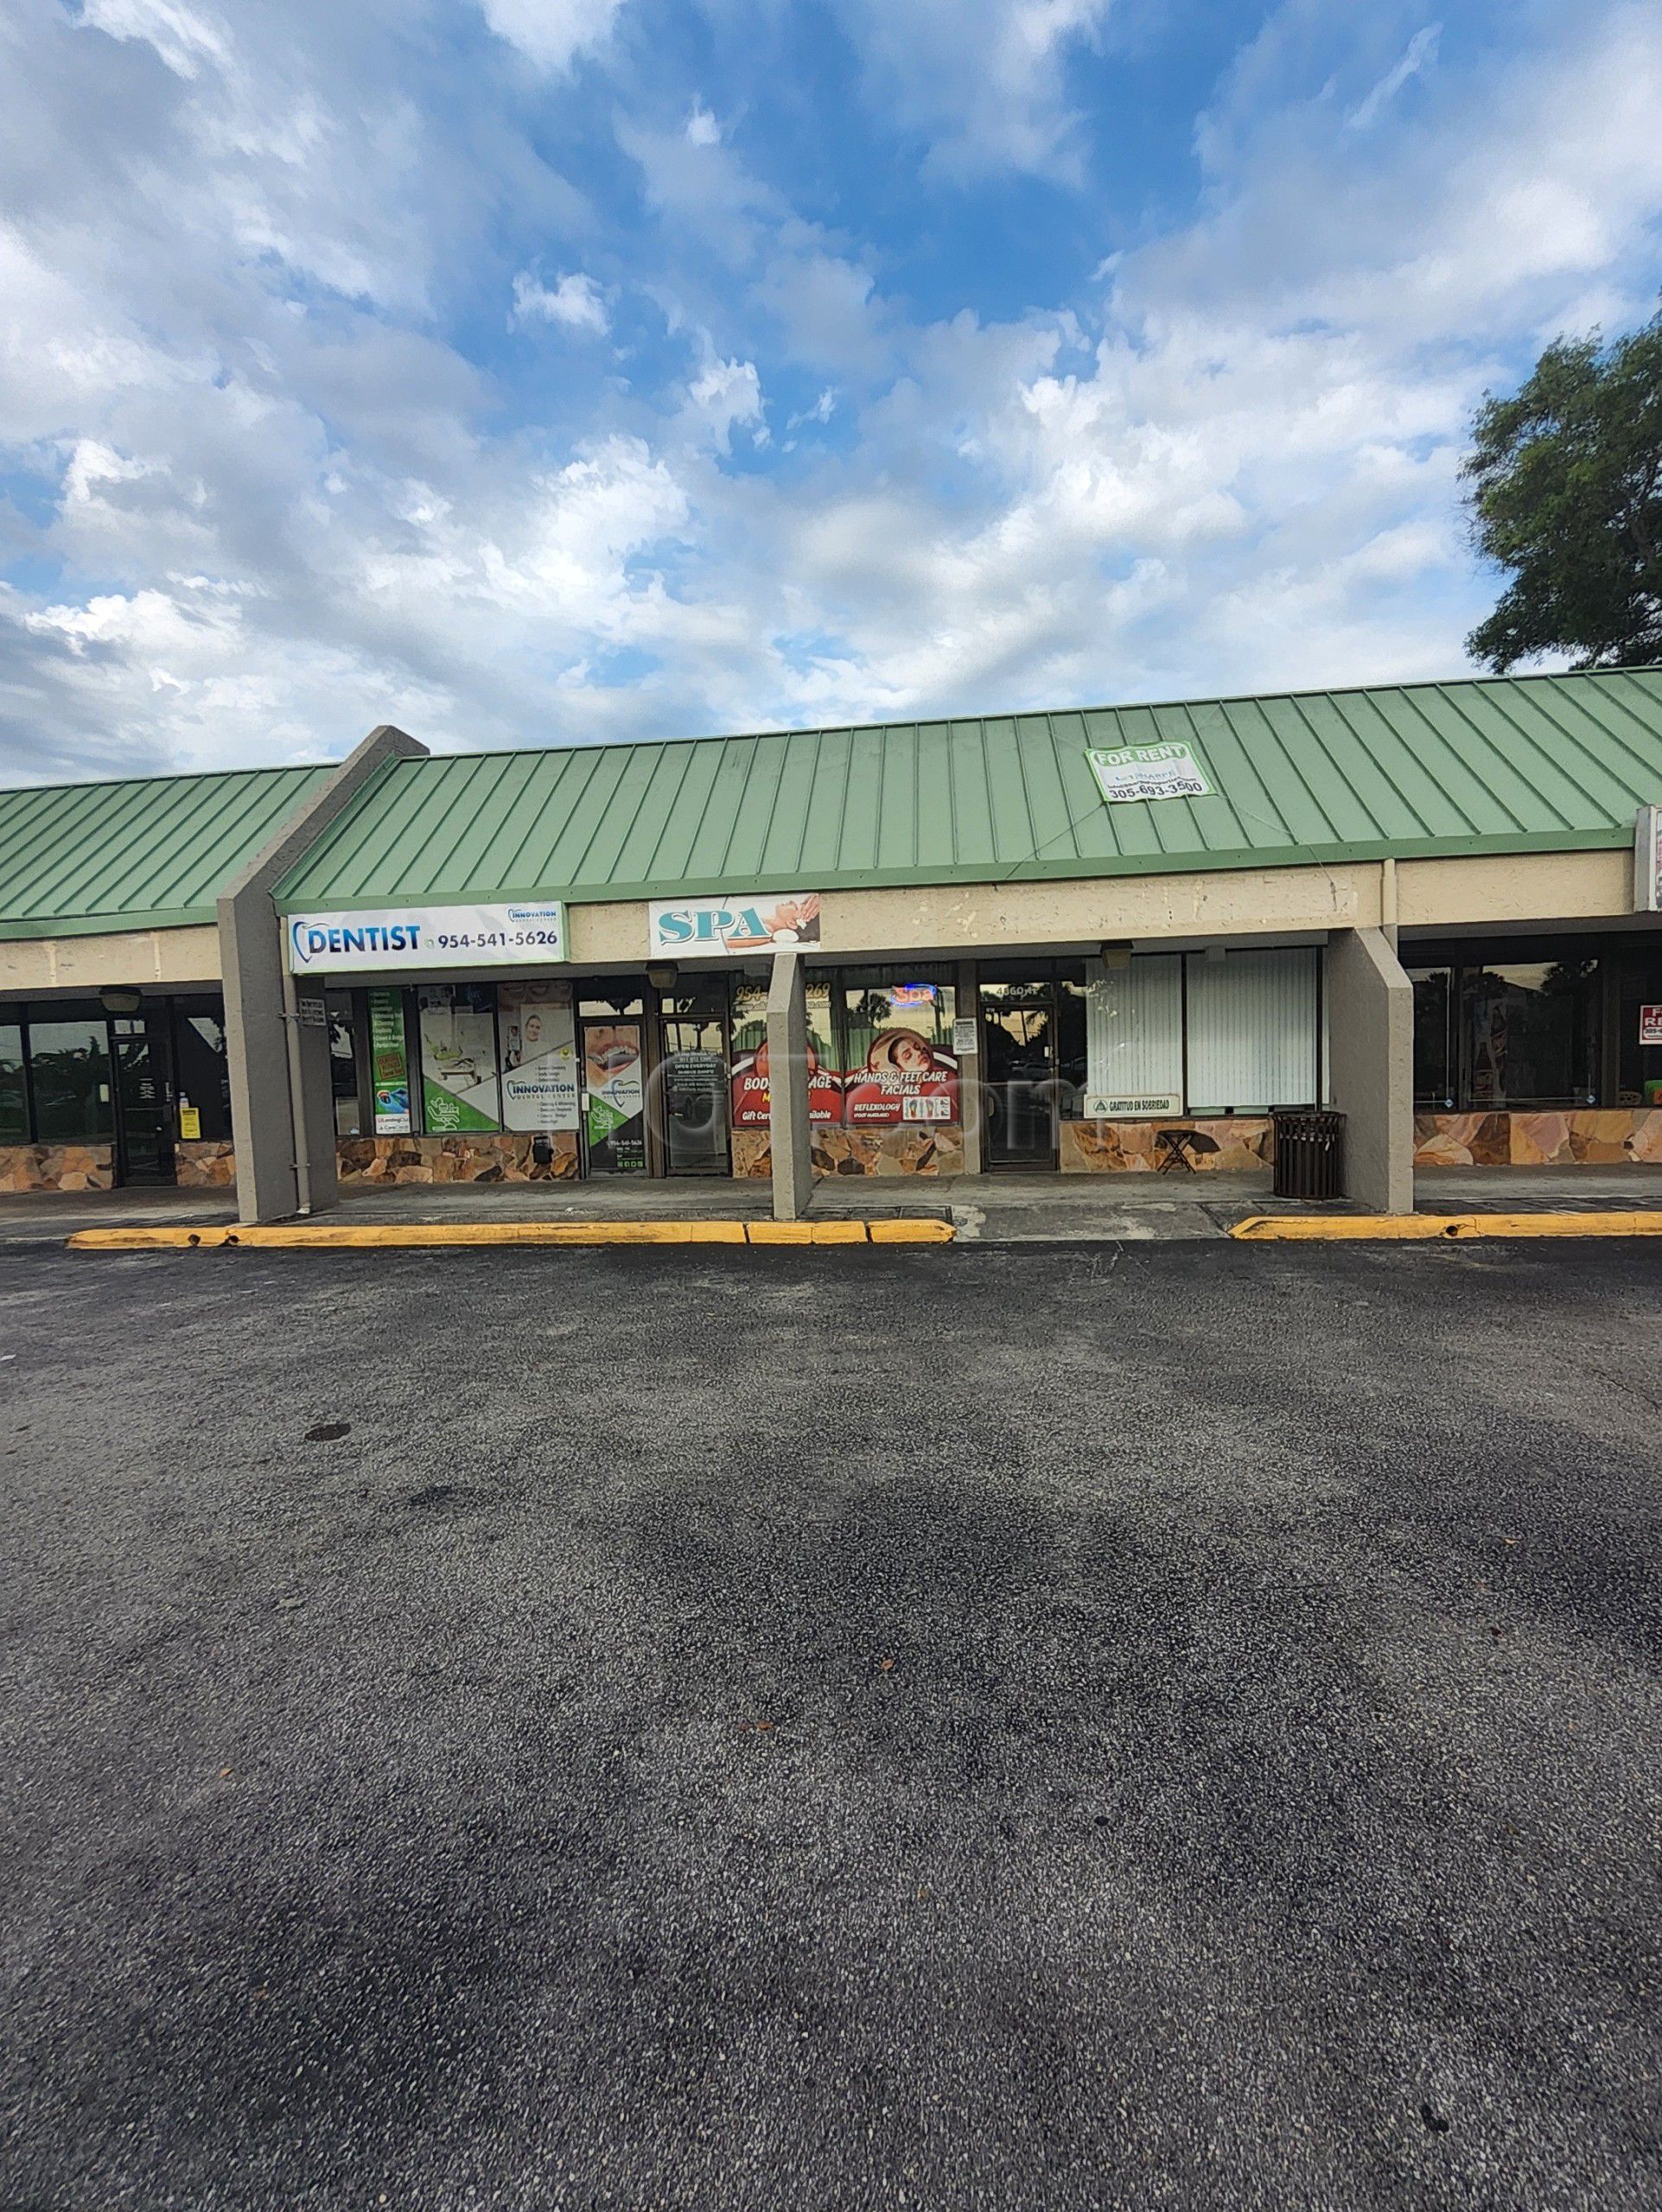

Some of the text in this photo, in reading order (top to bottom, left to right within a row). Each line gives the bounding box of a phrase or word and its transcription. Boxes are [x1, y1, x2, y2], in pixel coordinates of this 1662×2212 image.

[1097, 746, 1184, 765] FOR RENT
[1109, 780, 1202, 798] 305-693-3500
[659, 907, 772, 945] SPA
[308, 925, 558, 954] DENTIST 954-541-5626
[744, 1075, 832, 1090] BOD AGE
[853, 1071, 948, 1084] HANDS & FEET CARE
[513, 1083, 575, 1094] INNOVATION
[881, 1084, 921, 1096] FACIALS
[742, 1110, 756, 1120] Gift
[853, 1103, 901, 1113] REFLEXOLOGY
